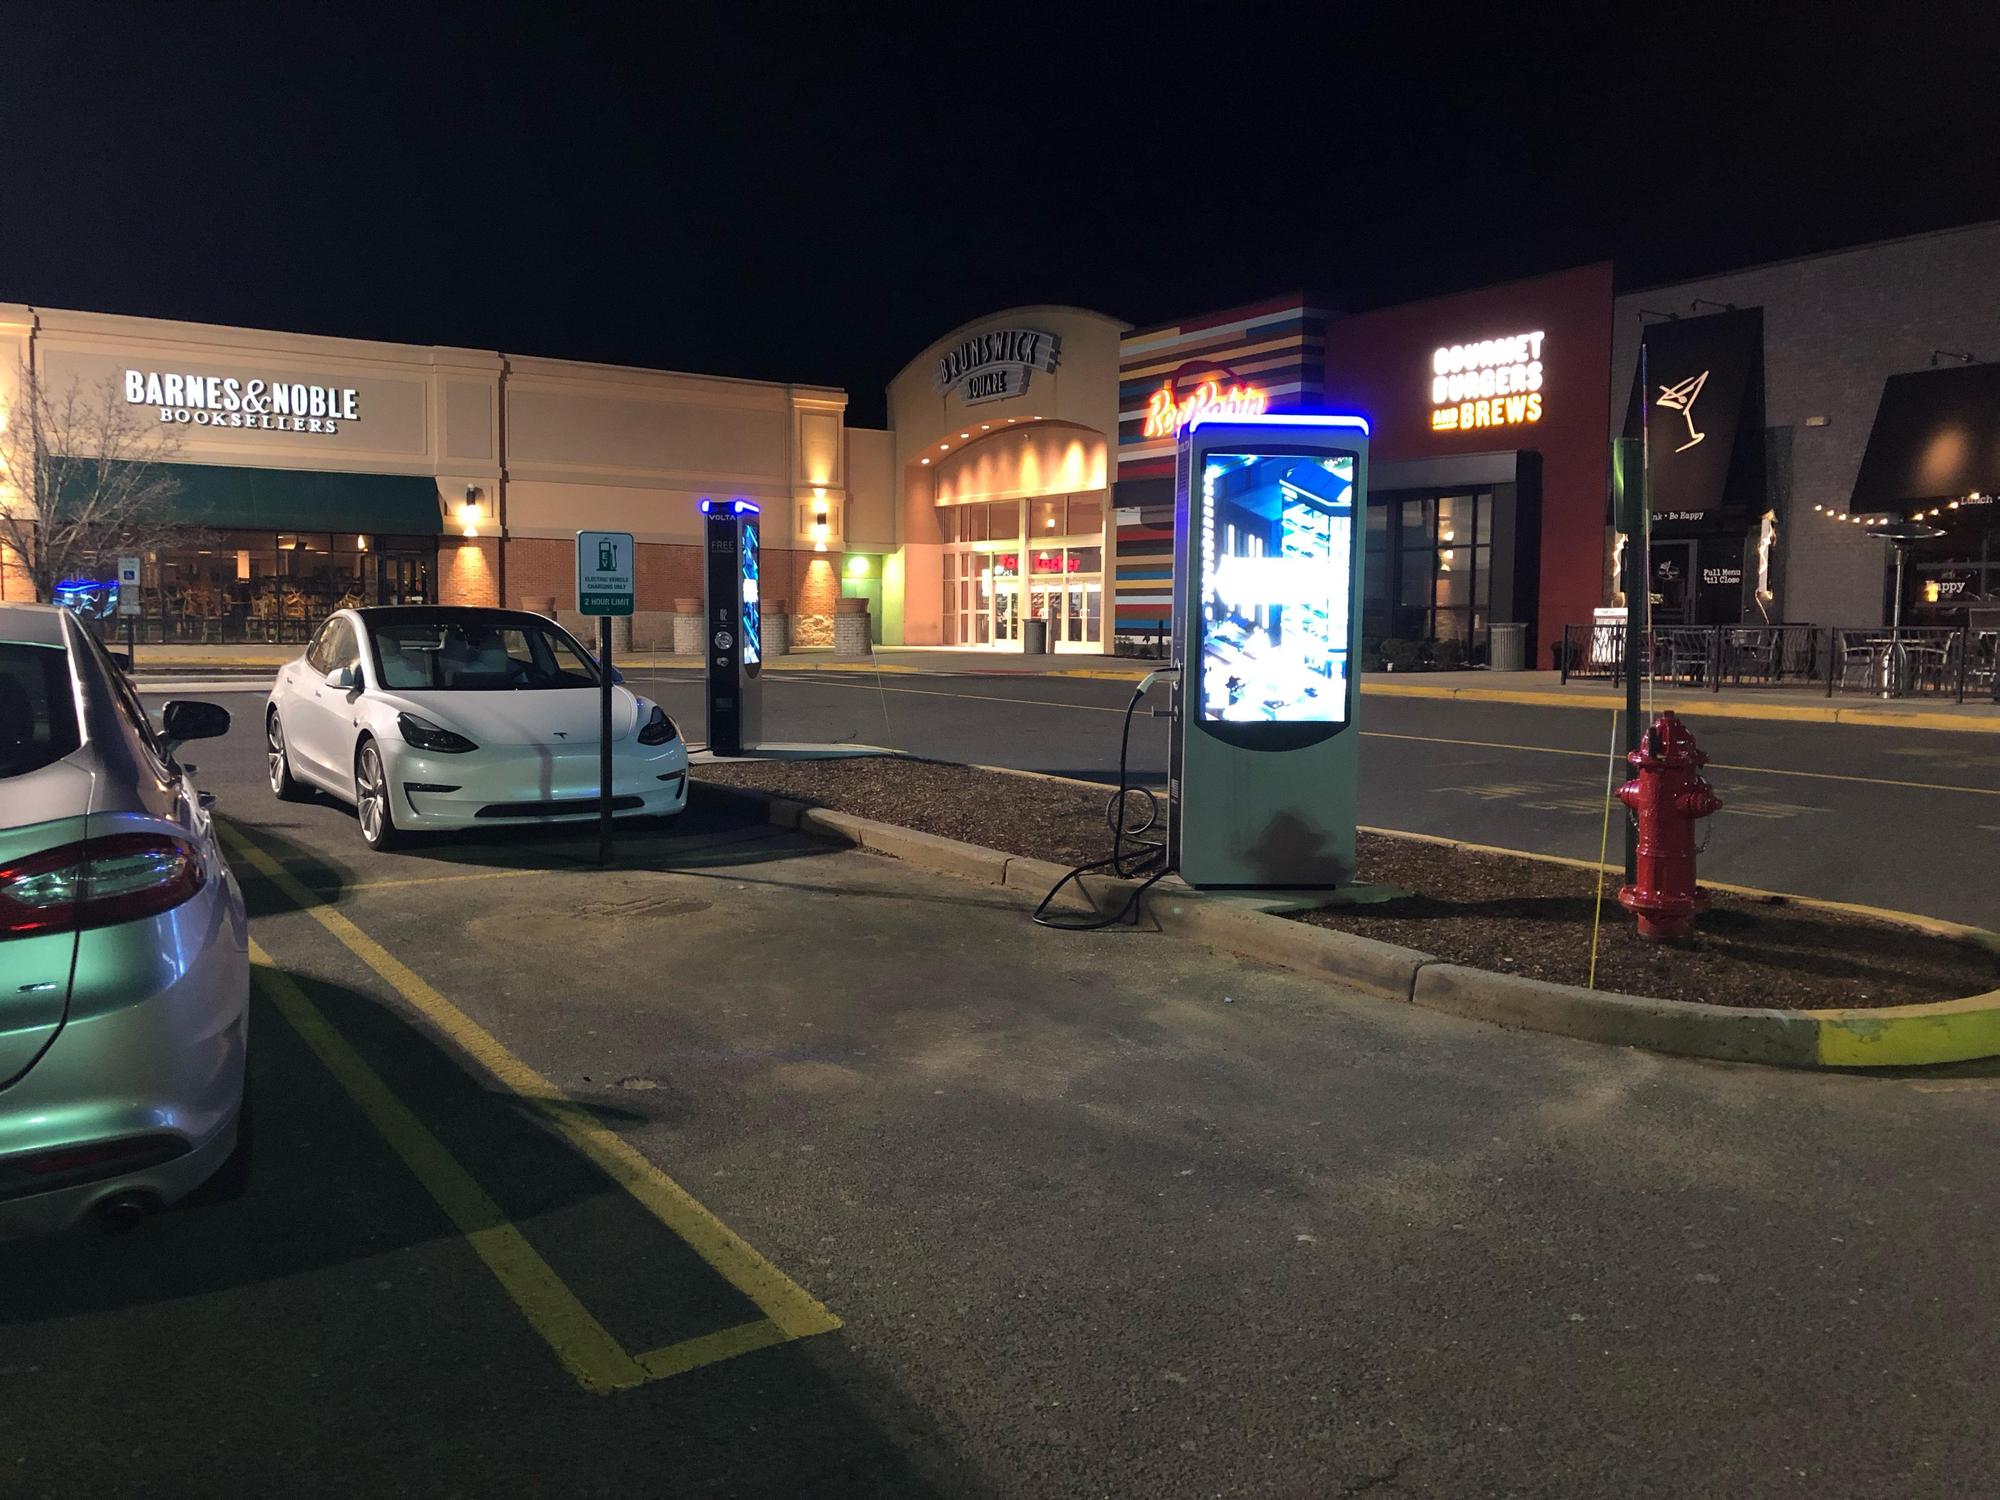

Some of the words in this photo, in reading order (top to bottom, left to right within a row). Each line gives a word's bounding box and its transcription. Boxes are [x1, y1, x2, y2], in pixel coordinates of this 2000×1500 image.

[940, 331, 1039, 384] BRUNSWICK
[967, 371, 1008, 399] SQUARE
[1432, 360, 1543, 404] BURGERS
[159, 408, 337, 434] BOOKSELLERS
[1432, 407, 1459, 425] AND
[1459, 392, 1543, 430] BREWS
[1680, 511, 1704, 521] Happy
[711, 540, 735, 550] FREE
[1719, 576, 1740, 584] Close
[584, 598, 590, 606] 2
[591, 598, 610, 606] HOUR
[611, 598, 630, 606] LIMIT
